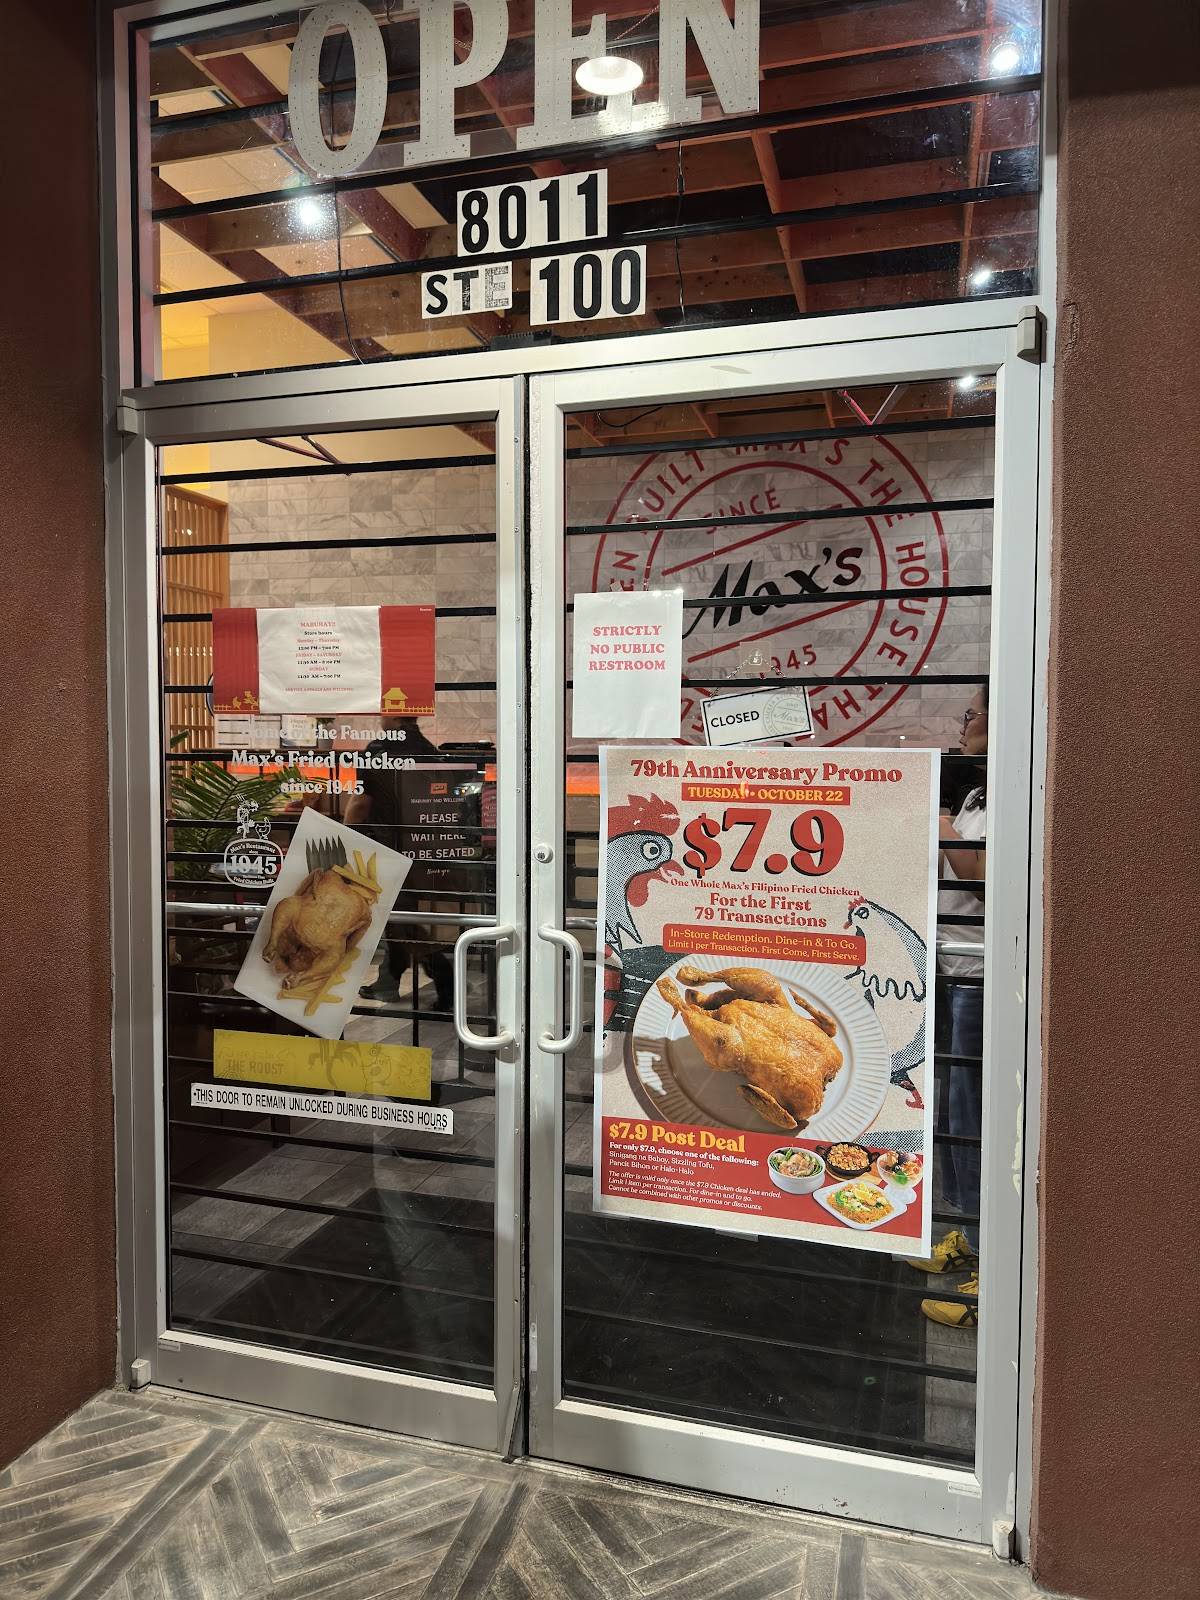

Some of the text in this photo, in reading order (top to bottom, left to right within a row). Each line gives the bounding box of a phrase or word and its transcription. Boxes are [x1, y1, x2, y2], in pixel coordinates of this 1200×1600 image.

[288, 0, 760, 177] OPEN
[461, 172, 600, 254] 8011
[424, 250, 641, 322] STE 100
[735, 438, 850, 467] MAXS
[876, 541, 930, 667] HOUSE
[683, 546, 863, 638] Max's
[592, 624, 662, 636] STRICTLY
[590, 642, 665, 655] NO PUBLIC
[588, 660, 666, 671] RESTROOM
[710, 710, 760, 728] CLOSED
[312, 725, 337, 739] the
[340, 725, 407, 741] Famous
[232, 749, 416, 770] Max's Fried Chicken
[631, 760, 902, 784] 79th Anniversary Promo
[281, 778, 365, 795] since 1945
[758, 788, 823, 801] OCTOBER
[825, 790, 843, 802] 22
[419, 813, 459, 824] PLEASE
[440, 833, 466, 841] HE
[683, 807, 845, 878] $7.9
[419, 850, 432, 859] BE
[436, 847, 475, 859] SEATED
[230, 855, 278, 875] 1945
[671, 879, 860, 897] One Whole Max's Filipino Fried Chicken
[709, 892, 811, 911] For the First
[694, 907, 827, 928] 79 Transactions
[670, 928, 710, 940] In-Store
[775, 934, 813, 946] Dine-in
[815, 938, 823, 948] &
[825, 939, 838, 948] To
[840, 940, 858, 950] Go.
[668, 941, 689, 949] Limit
[695, 944, 709, 952] per
[761, 946, 780, 954] First
[812, 949, 831, 958] First
[227, 1059, 284, 1075] THE ROOST
[196, 1088, 448, 1128] THIS DOOR TO REMAIN UNLOCKED DURING BUSINESS HOURS
[610, 1122, 745, 1152] $7.9 Post Deal
[609, 1151, 637, 1161] Sinigang
[671, 1157, 697, 1168] Sizzling
[623, 1144, 638, 1152] only
[658, 1147, 683, 1156] choose
[708, 1153, 720, 1161] the
[721, 1155, 759, 1166] following:
[631, 1162, 650, 1170] Bihon
[608, 1177, 624, 1185] Limit
[700, 1188, 722, 1197] dine-in
[722, 1191, 735, 1199] and
[620, 1171, 635, 1179] offer
[642, 1174, 656, 1182] valid
[685, 1179, 695, 1187] the
[709, 1183, 734, 1192] Chicken
[735, 1186, 748, 1194] deal
[749, 1187, 760, 1195] has
[638, 1188, 668, 1198] combined
[668, 1191, 681, 1199] with
[682, 1193, 698, 1202] other
[698, 1197, 723, 1205] promos
